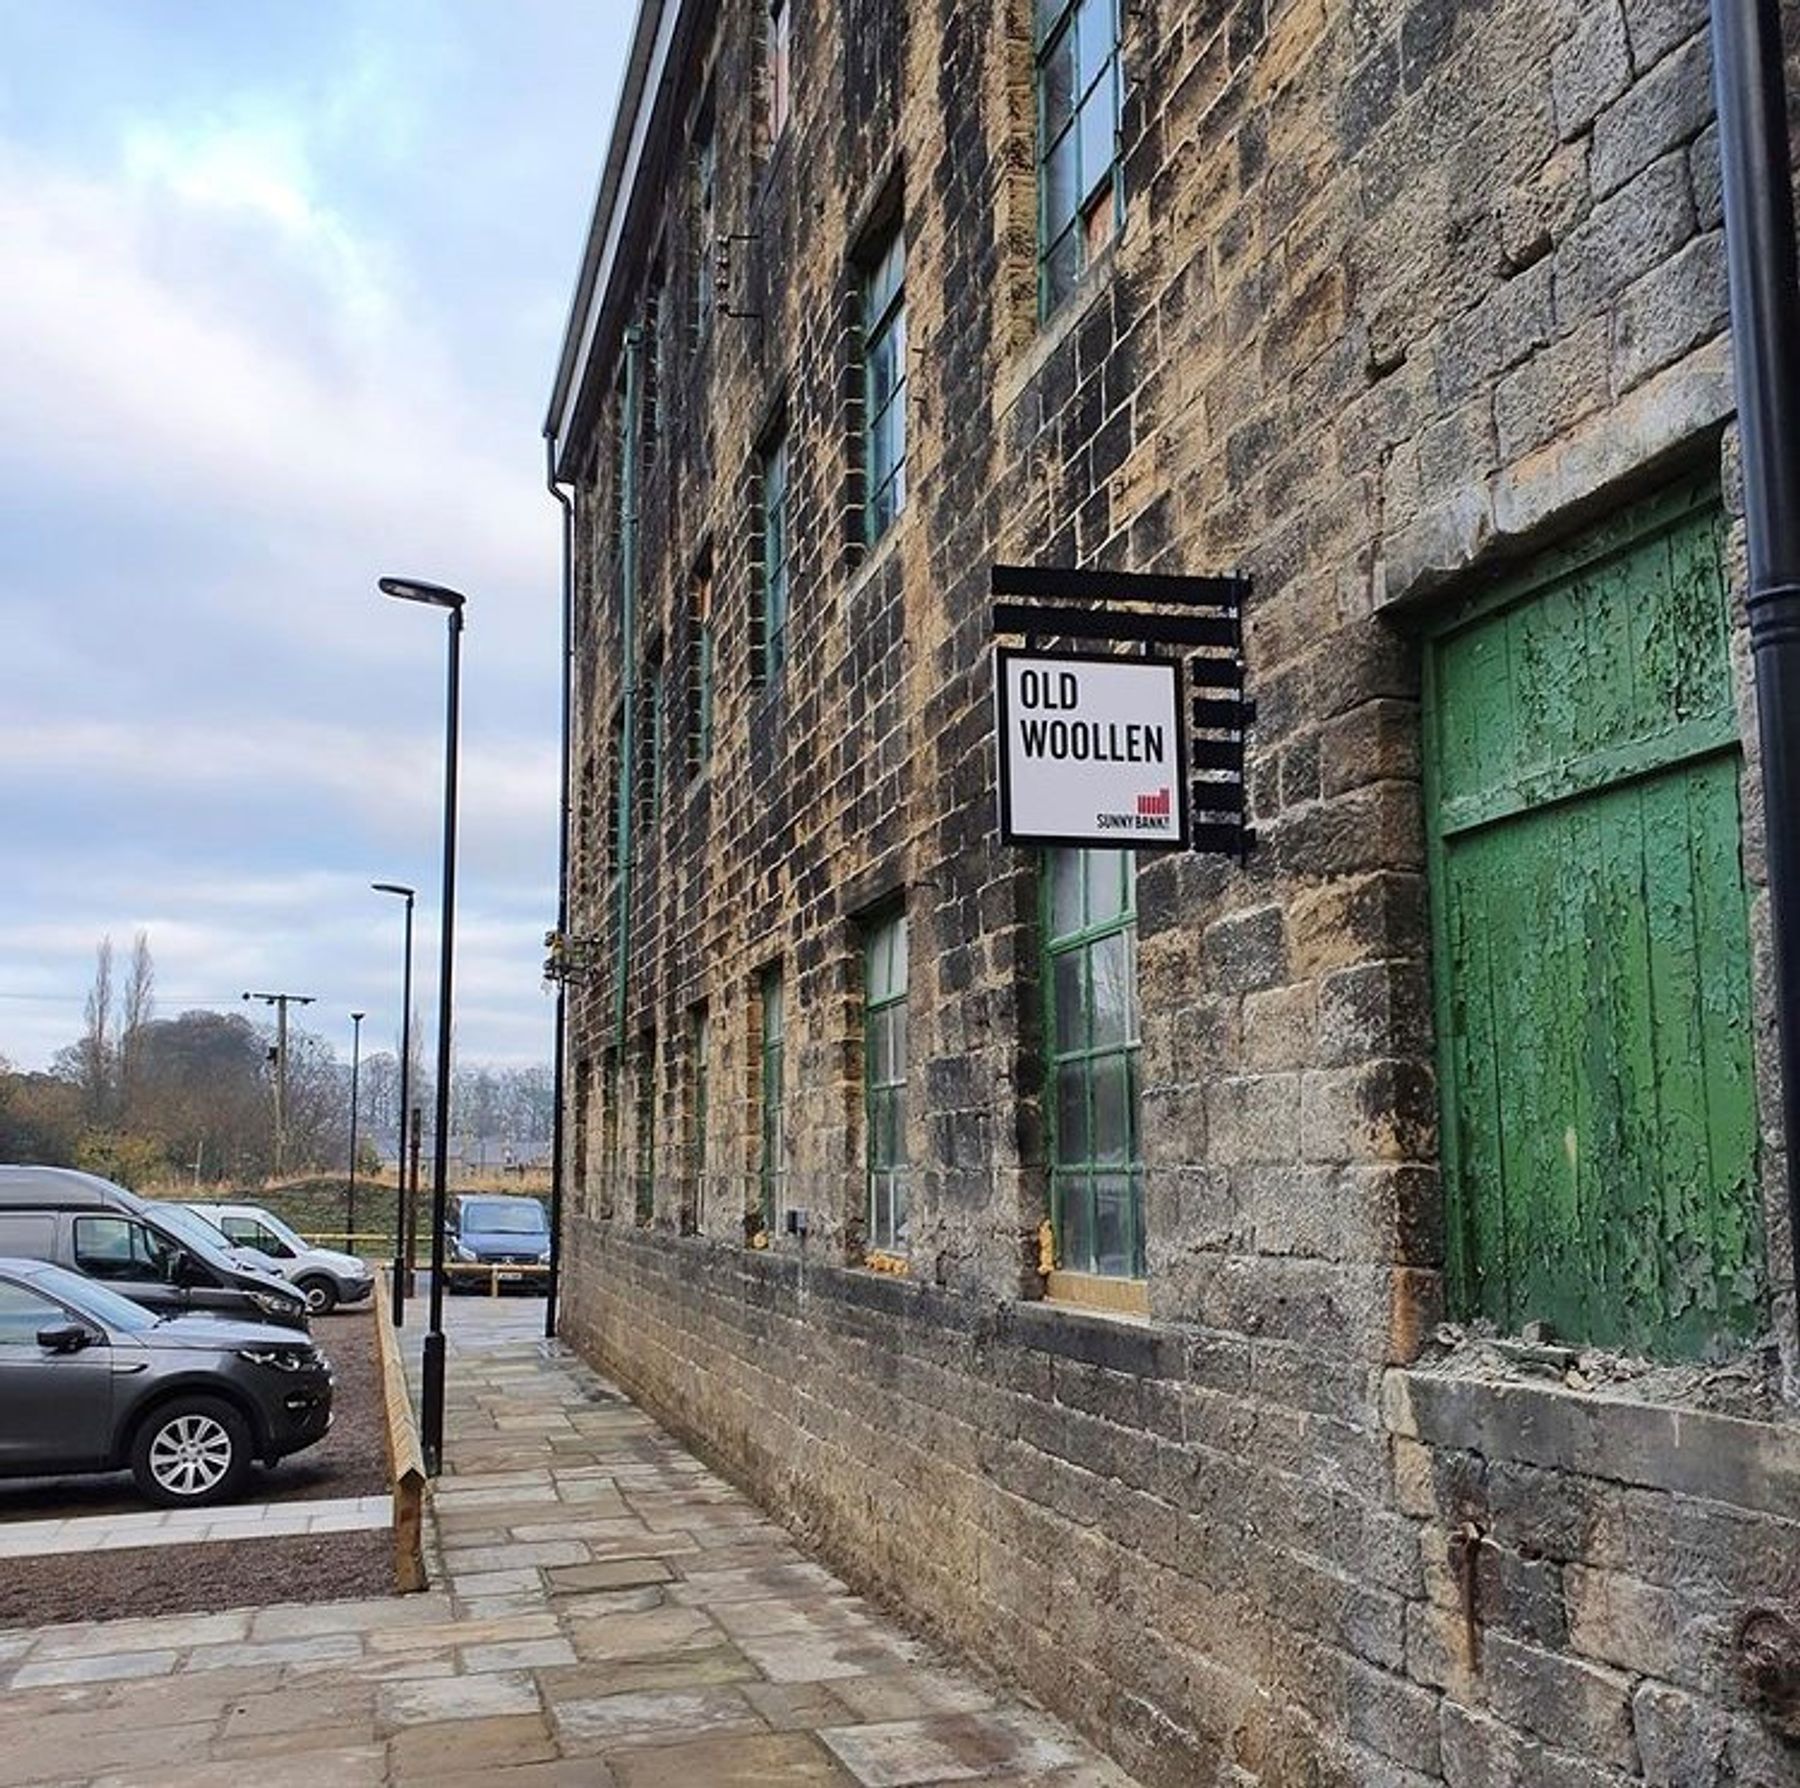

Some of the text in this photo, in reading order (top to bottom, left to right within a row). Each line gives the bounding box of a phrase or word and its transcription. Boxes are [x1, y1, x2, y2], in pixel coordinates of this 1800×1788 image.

[1020, 670, 1078, 710] OLD
[1020, 720, 1164, 763] WOOLLEN
[1096, 813, 1133, 829] SUNNY
